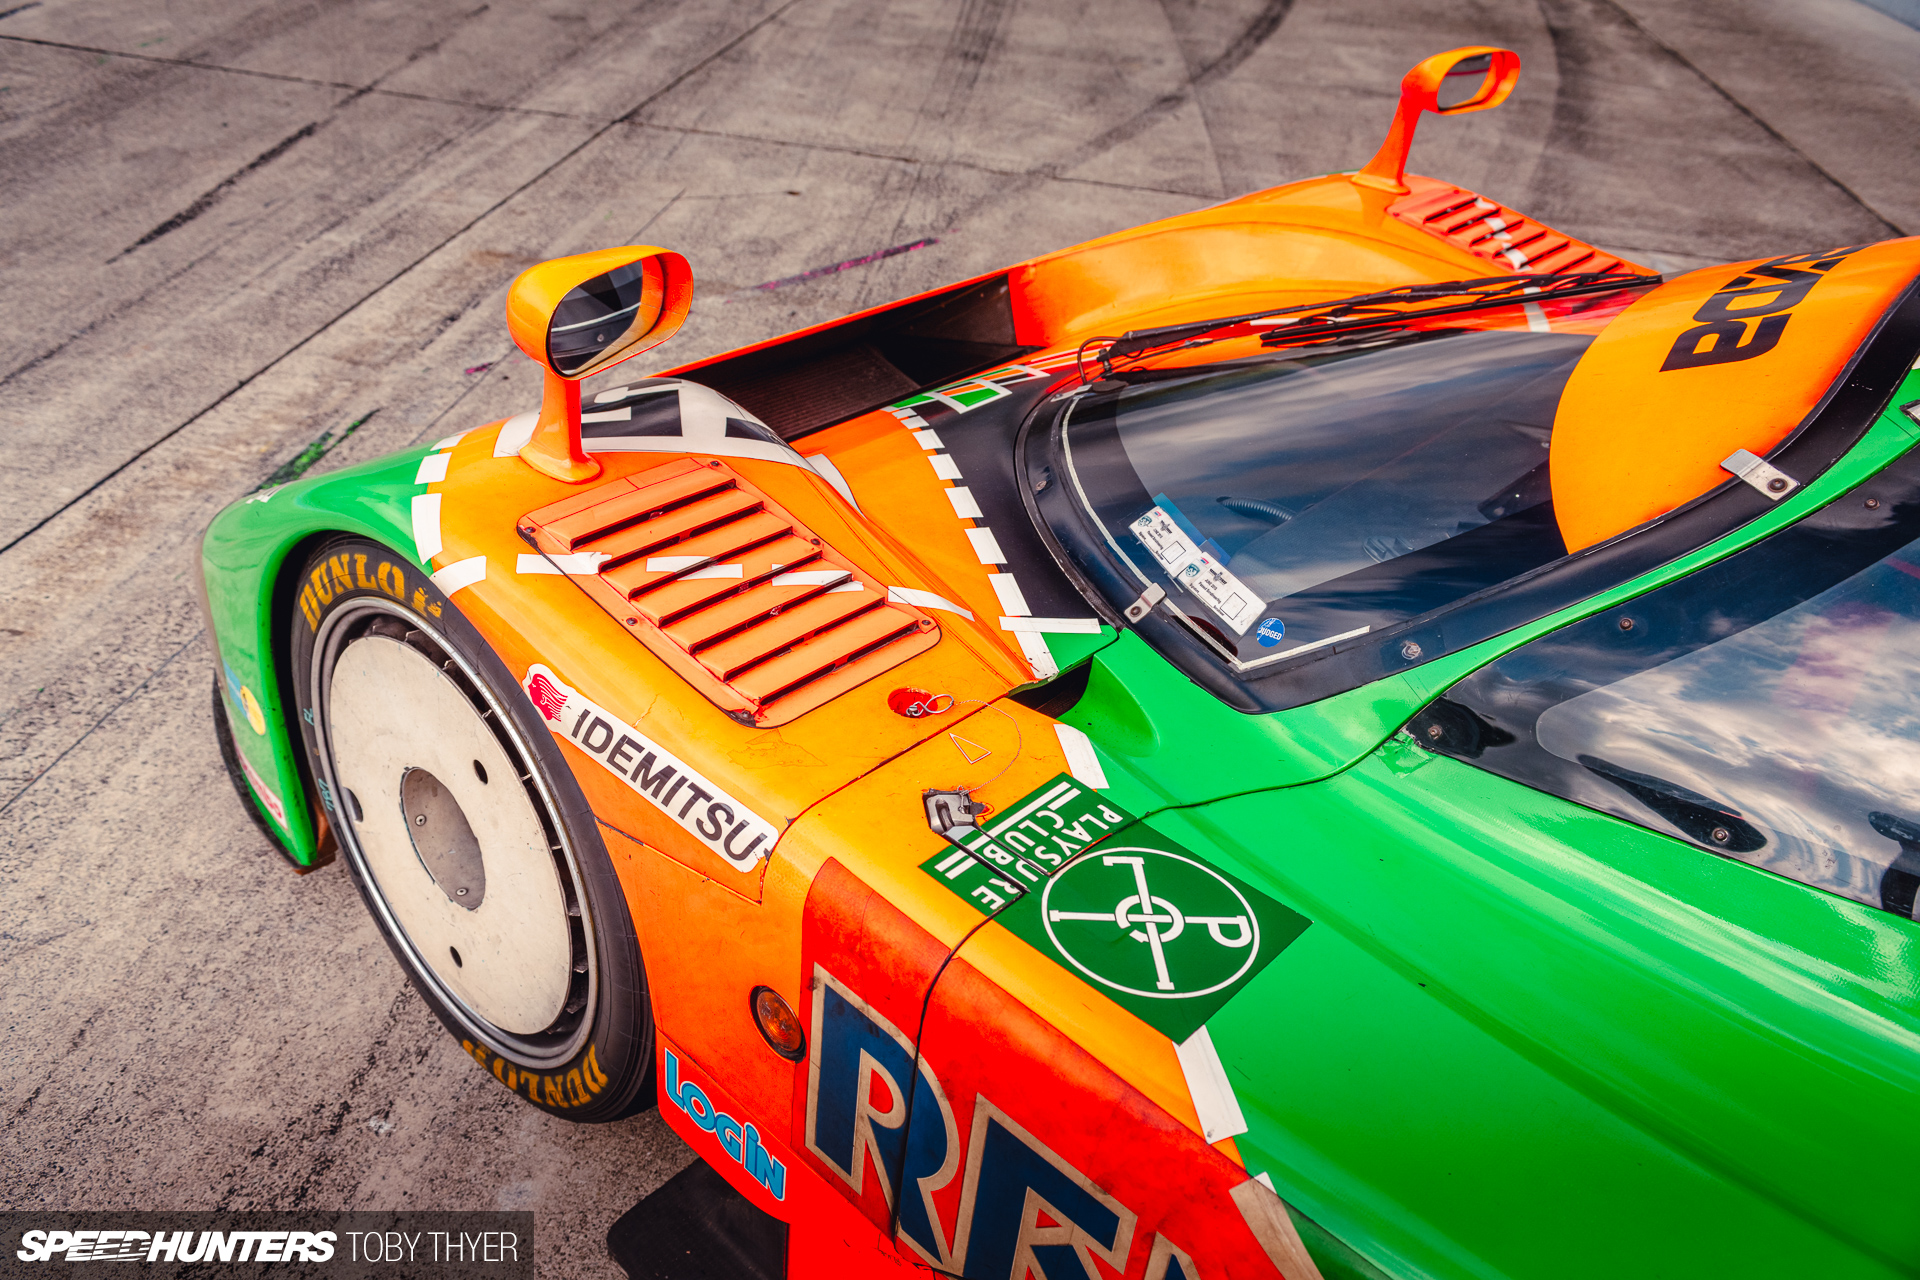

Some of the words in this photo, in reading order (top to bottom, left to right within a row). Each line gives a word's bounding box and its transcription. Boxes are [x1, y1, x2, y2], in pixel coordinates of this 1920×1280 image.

[1256, 625, 1283, 641] JUDGED
[571, 709, 768, 861] IDEMITSU
[971, 804, 1124, 911] PLAYSURE
[983, 810, 1065, 865] CLUB
